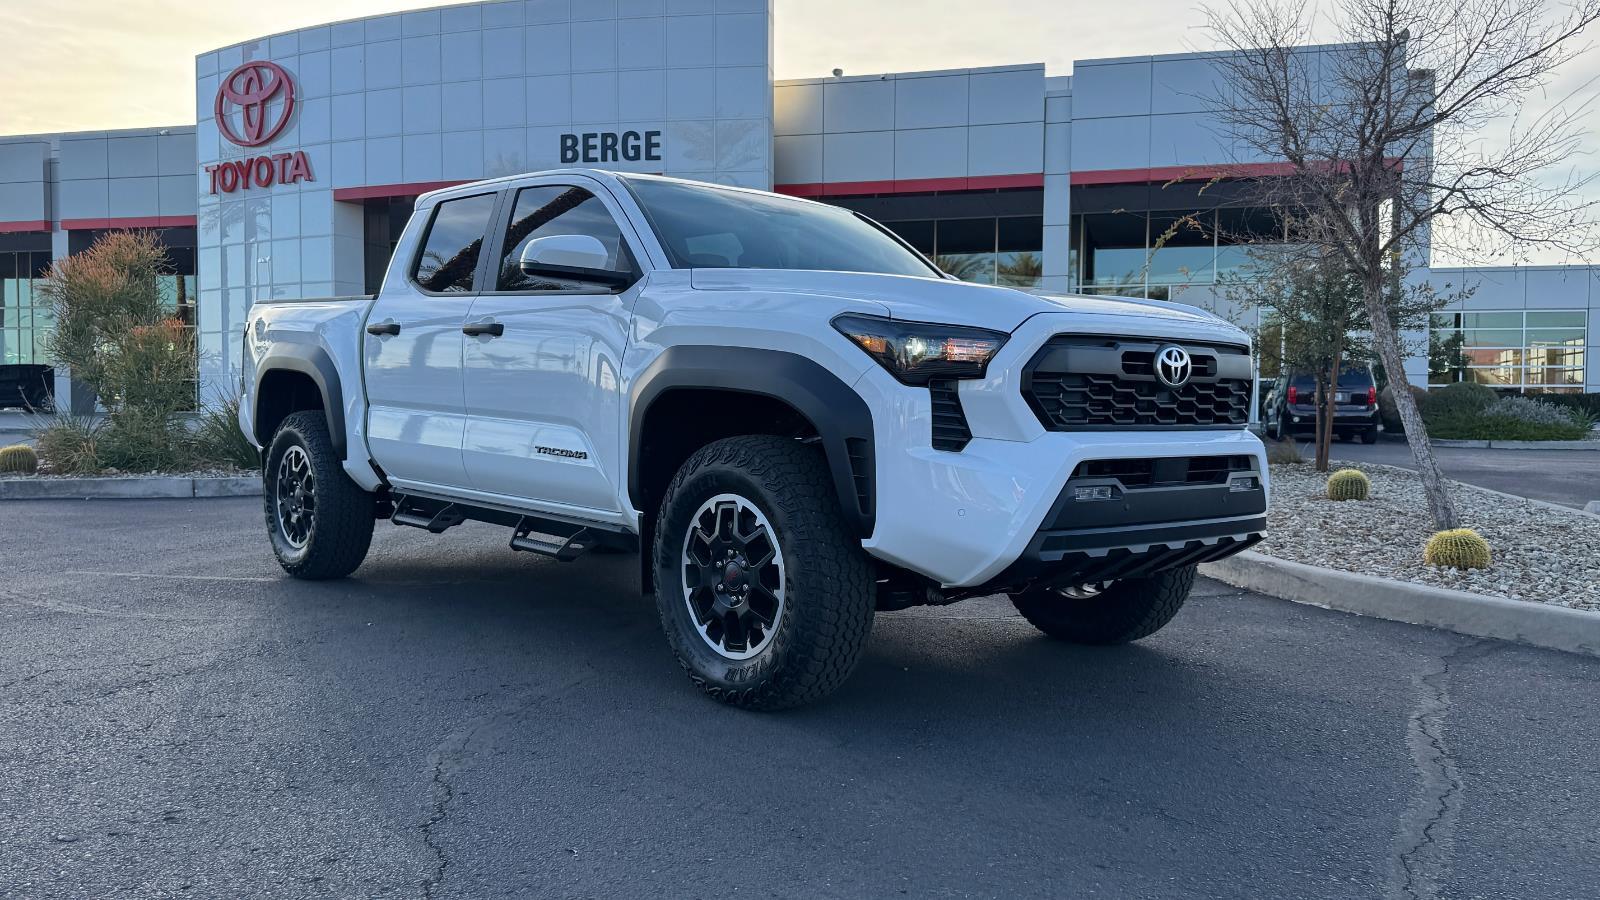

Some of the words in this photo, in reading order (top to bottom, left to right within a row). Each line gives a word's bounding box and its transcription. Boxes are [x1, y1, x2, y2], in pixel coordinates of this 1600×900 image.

[560, 130, 662, 163] BERGE
[205, 151, 313, 195] TOYOTA
[534, 445, 588, 460] TACOMA
